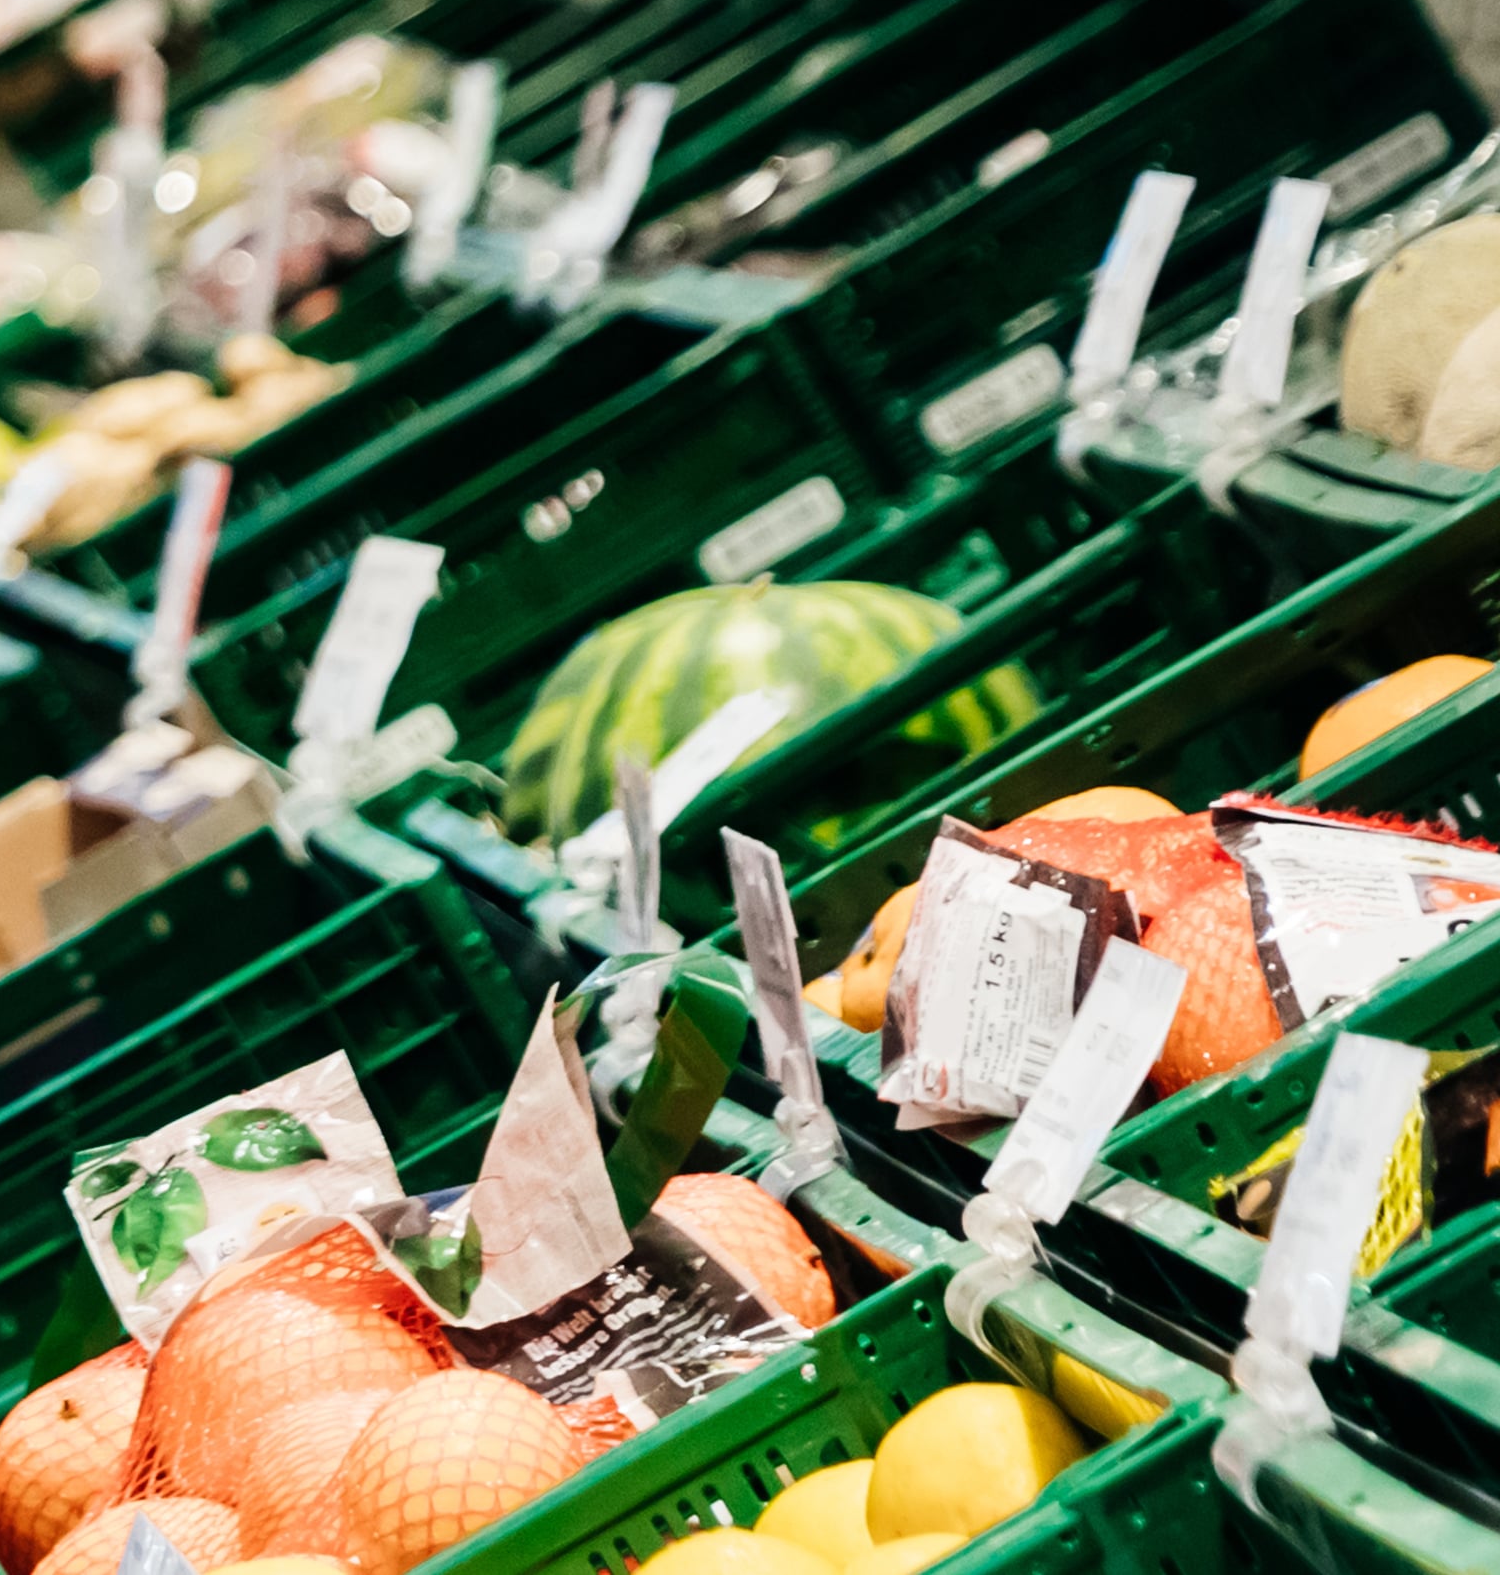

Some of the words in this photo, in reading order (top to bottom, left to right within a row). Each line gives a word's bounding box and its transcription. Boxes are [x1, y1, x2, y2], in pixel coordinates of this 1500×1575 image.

[985, 951, 1005, 990] 1.5
[522, 1335, 559, 1362] Die
[551, 1310, 596, 1344] Welt
